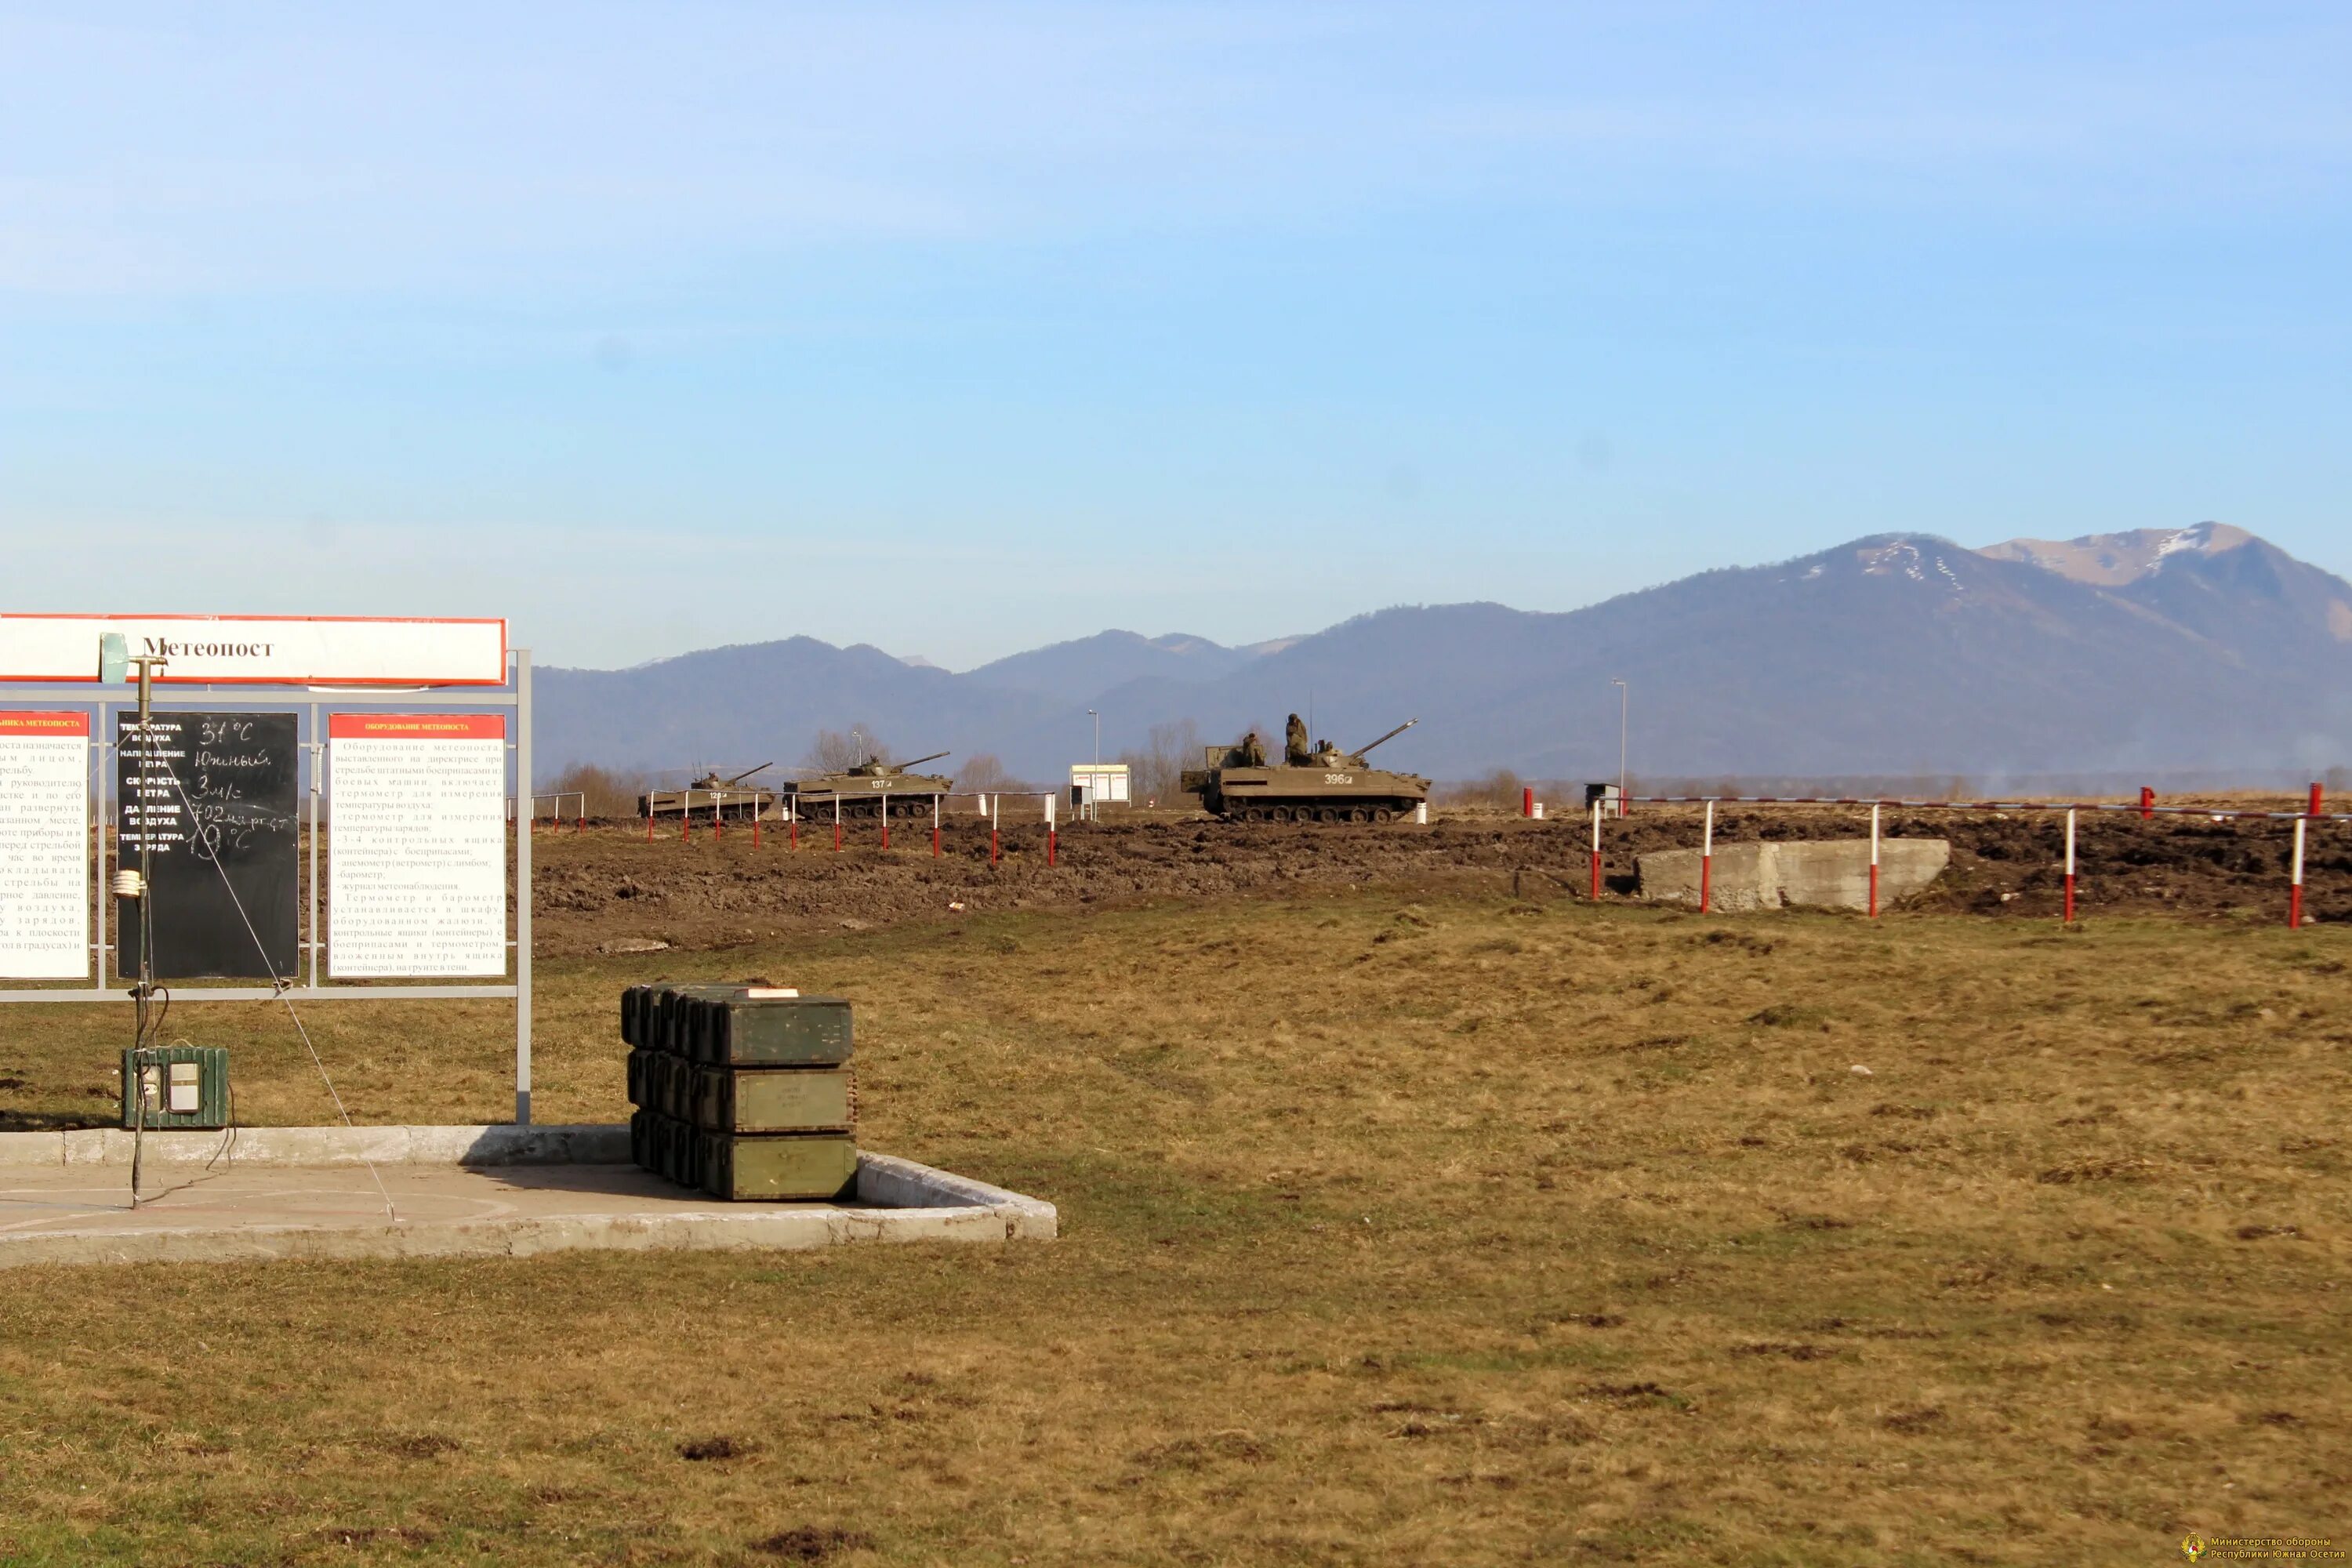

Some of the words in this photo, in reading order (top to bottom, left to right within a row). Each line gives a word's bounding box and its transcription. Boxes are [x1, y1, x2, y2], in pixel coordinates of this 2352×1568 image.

[143, 636, 274, 657] Метеопост
[0, 719, 24, 728] НИКА
[343, 742, 424, 753] Оборудование
[194, 749, 271, 767] Южный
[336, 766, 375, 775] стрельбе
[426, 766, 490, 775] боеприпасами
[125, 776, 181, 786] СКРОСТЬ
[1324, 774, 1345, 785] 396
[11, 780, 82, 789] руководителю
[871, 780, 885, 789] 137
[20, 805, 81, 814] развернуть
[125, 804, 181, 815] ДАЛЕНИЕ
[20, 828, 63, 838] приборы
[31, 840, 80, 851] стрельбой
[133, 843, 171, 852] ЗРЯДА
[333, 848, 392, 857] (контейнера)
[52, 855, 81, 864] время
[392, 859, 445, 869] (ветрометр)
[5, 878, 57, 888] стрельбы
[345, 894, 415, 903] Термометр
[442, 894, 502, 903] барометр
[333, 916, 427, 927] оборудованном
[433, 929, 492, 938] (контейнеры)
[333, 940, 407, 949] боеприпасами
